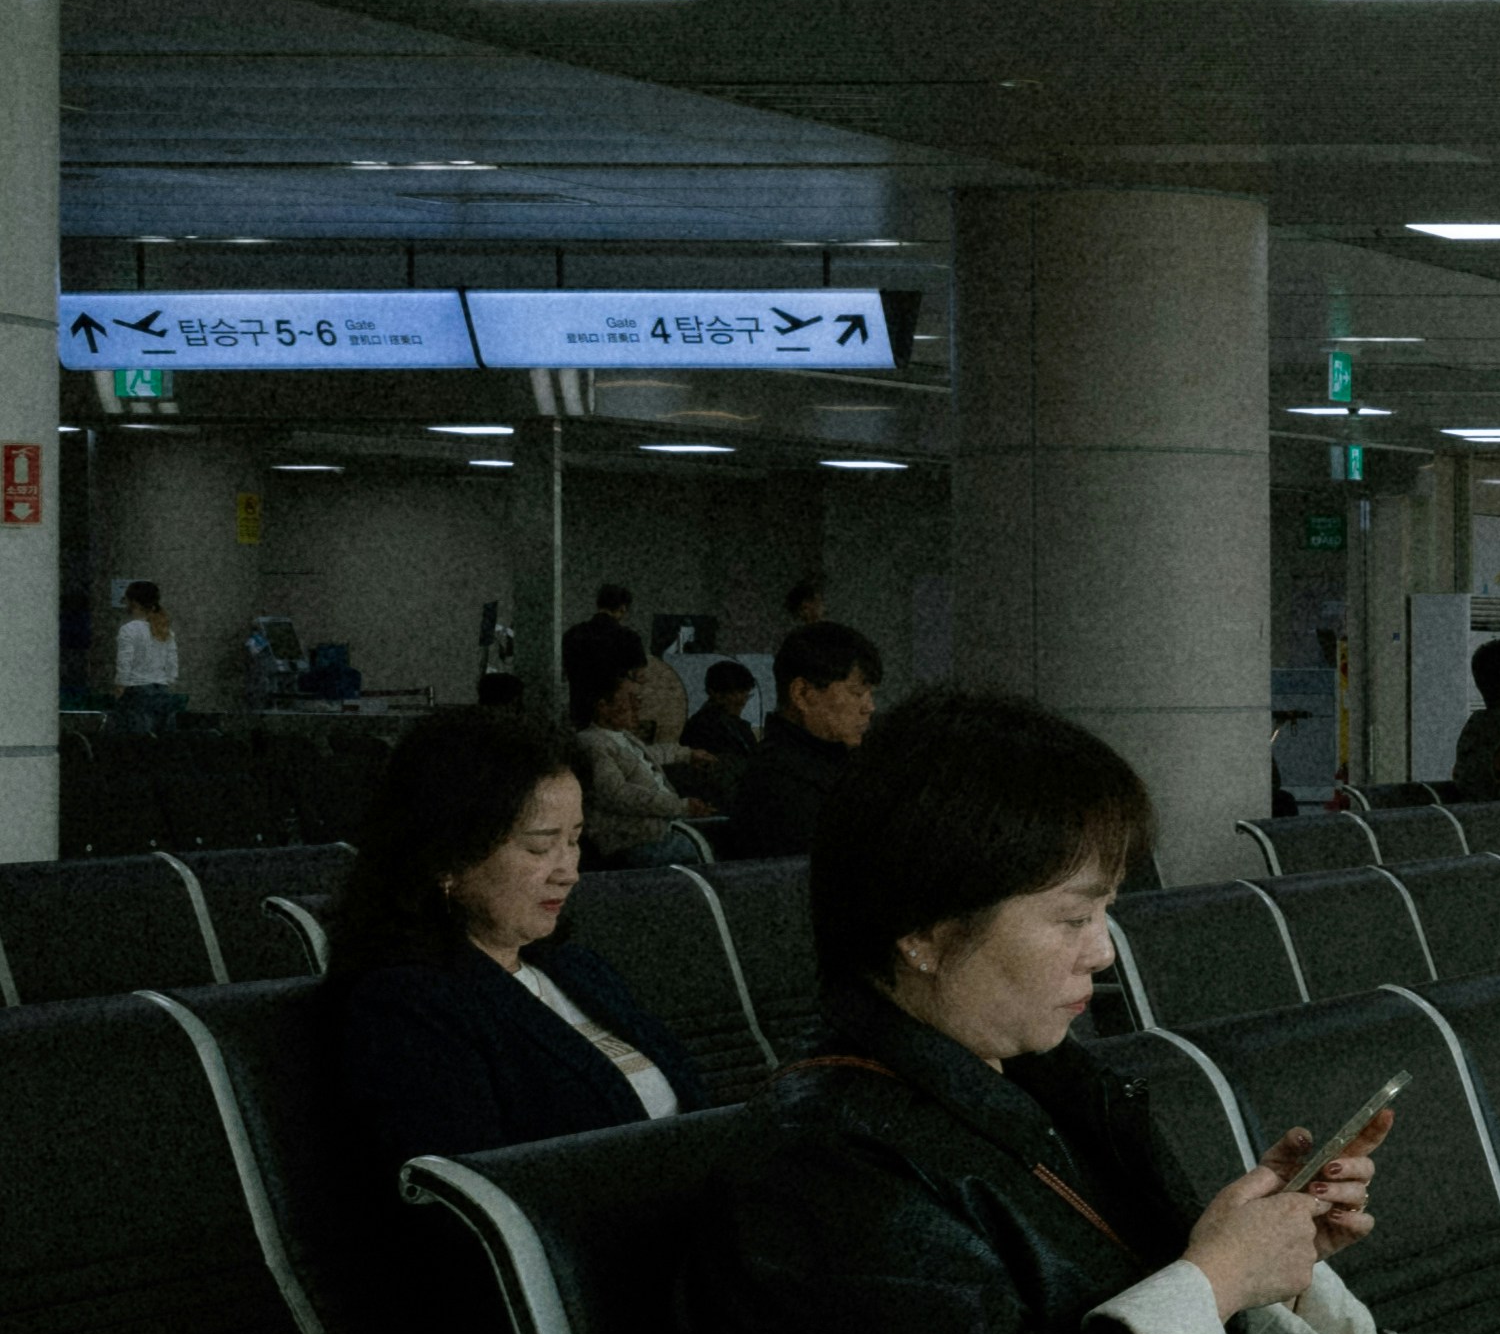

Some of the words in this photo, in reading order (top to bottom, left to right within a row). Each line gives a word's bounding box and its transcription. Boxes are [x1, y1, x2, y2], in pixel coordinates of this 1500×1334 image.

[344, 319, 376, 331] Gate
[605, 316, 638, 329] Gate
[650, 318, 671, 345] 4
[674, 316, 764, 345] 탑승구
[177, 319, 270, 347] 탑승구
[274, 319, 338, 347] 5~6
